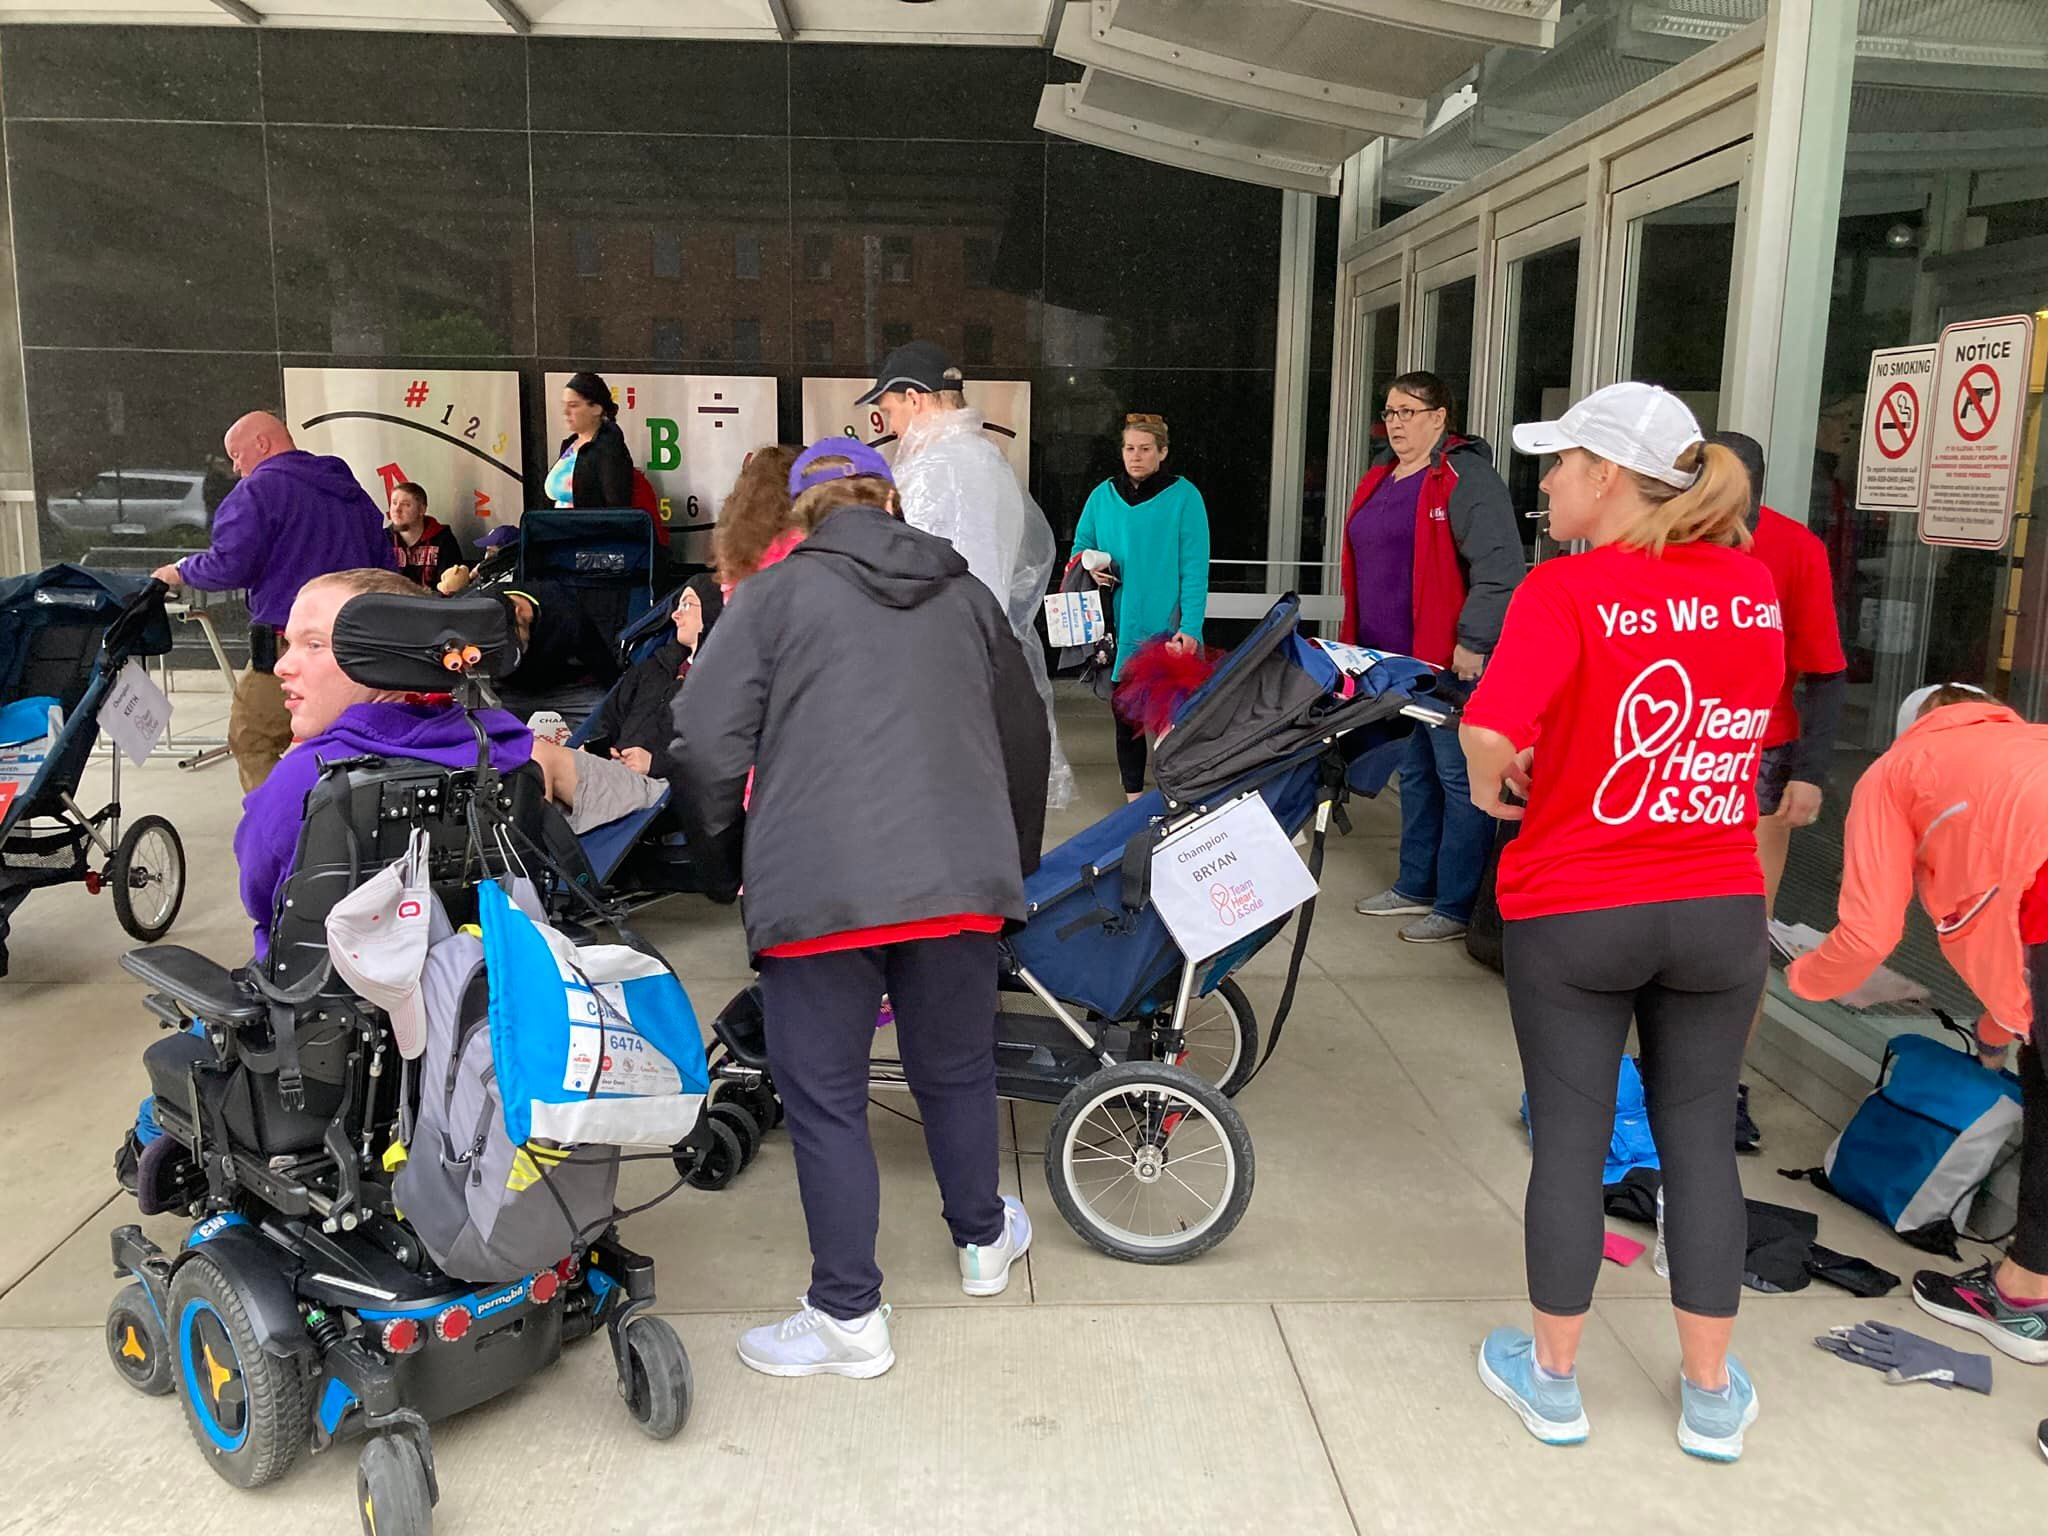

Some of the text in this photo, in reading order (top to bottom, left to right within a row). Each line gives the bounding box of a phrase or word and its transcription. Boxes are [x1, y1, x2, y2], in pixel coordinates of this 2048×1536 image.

[1956, 341, 2011, 362] NOTICE
[1876, 360, 1931, 377] NO SMOKING
[463, 416, 480, 439] 2
[492, 431, 509, 455] 3
[870, 411, 885, 434] 9
[645, 417, 682, 471] B
[659, 495, 699, 521] 5 6
[1597, 602, 1658, 638] Yes
[1666, 597, 1719, 632] We
[123, 696, 139, 718] KEITH
[1695, 697, 1771, 740] Team
[1661, 740, 1756, 783] Heart
[1177, 831, 1229, 864] Champion
[1192, 851, 1238, 882] BRYAN
[1229, 880, 1254, 896] Team
[1231, 889, 1257, 907] Heart
[610, 1035, 643, 1052] 6474
[477, 1286, 524, 1315] permobil
